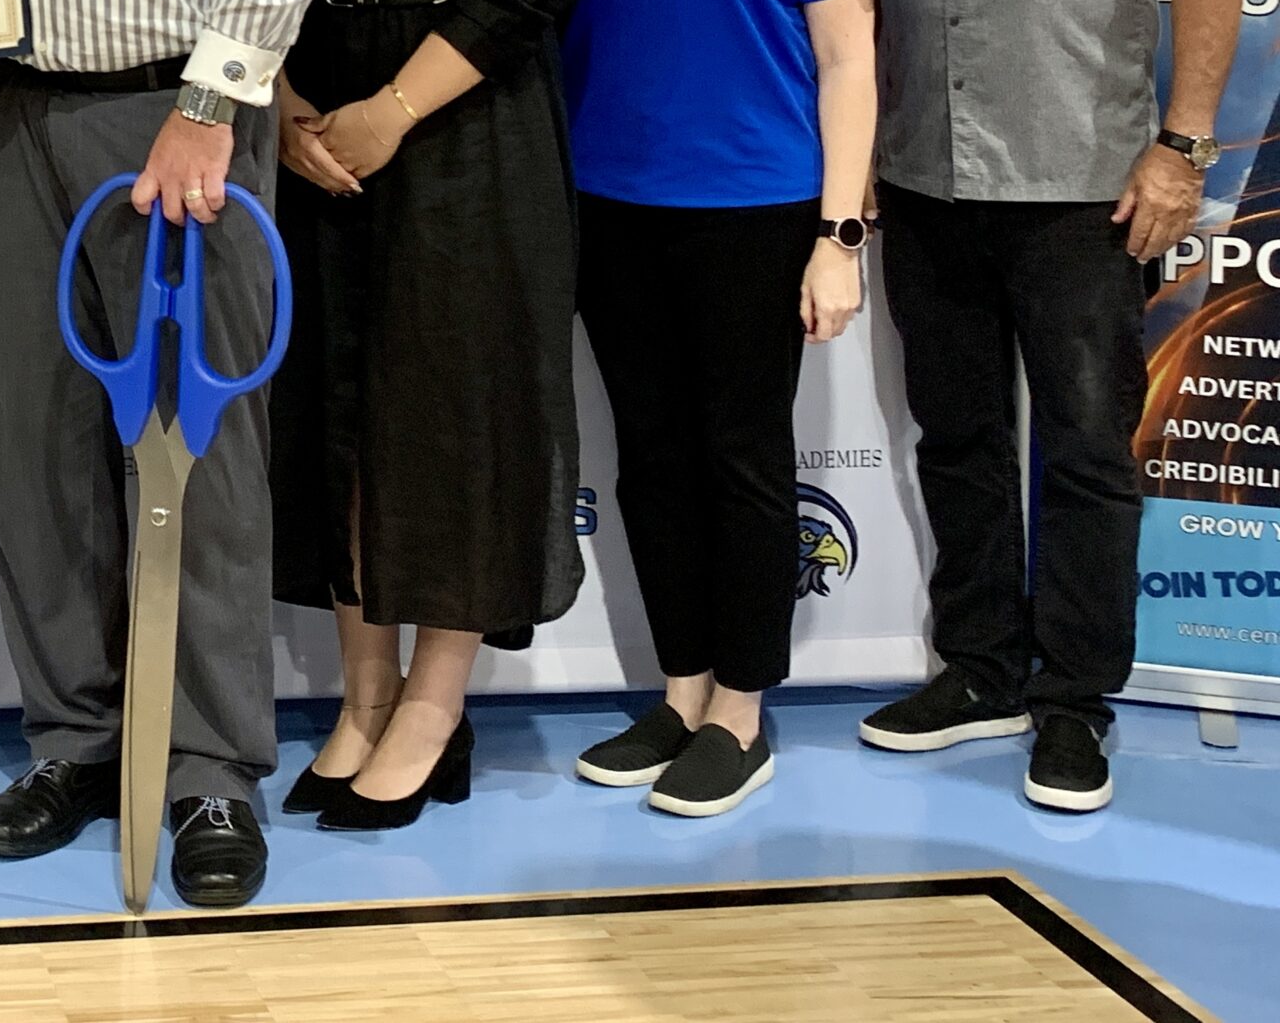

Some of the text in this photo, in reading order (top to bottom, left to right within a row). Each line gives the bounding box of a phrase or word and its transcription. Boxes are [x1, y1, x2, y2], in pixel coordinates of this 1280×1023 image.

[1163, 233, 1280, 290] PPO
[1162, 418, 1280, 446] ADVOCA
[795, 448, 882, 470] ADEMIES
[1144, 458, 1280, 489] CREDIBILI
[1179, 513, 1265, 540] GROW
[1176, 621, 1280, 645] www.cen
